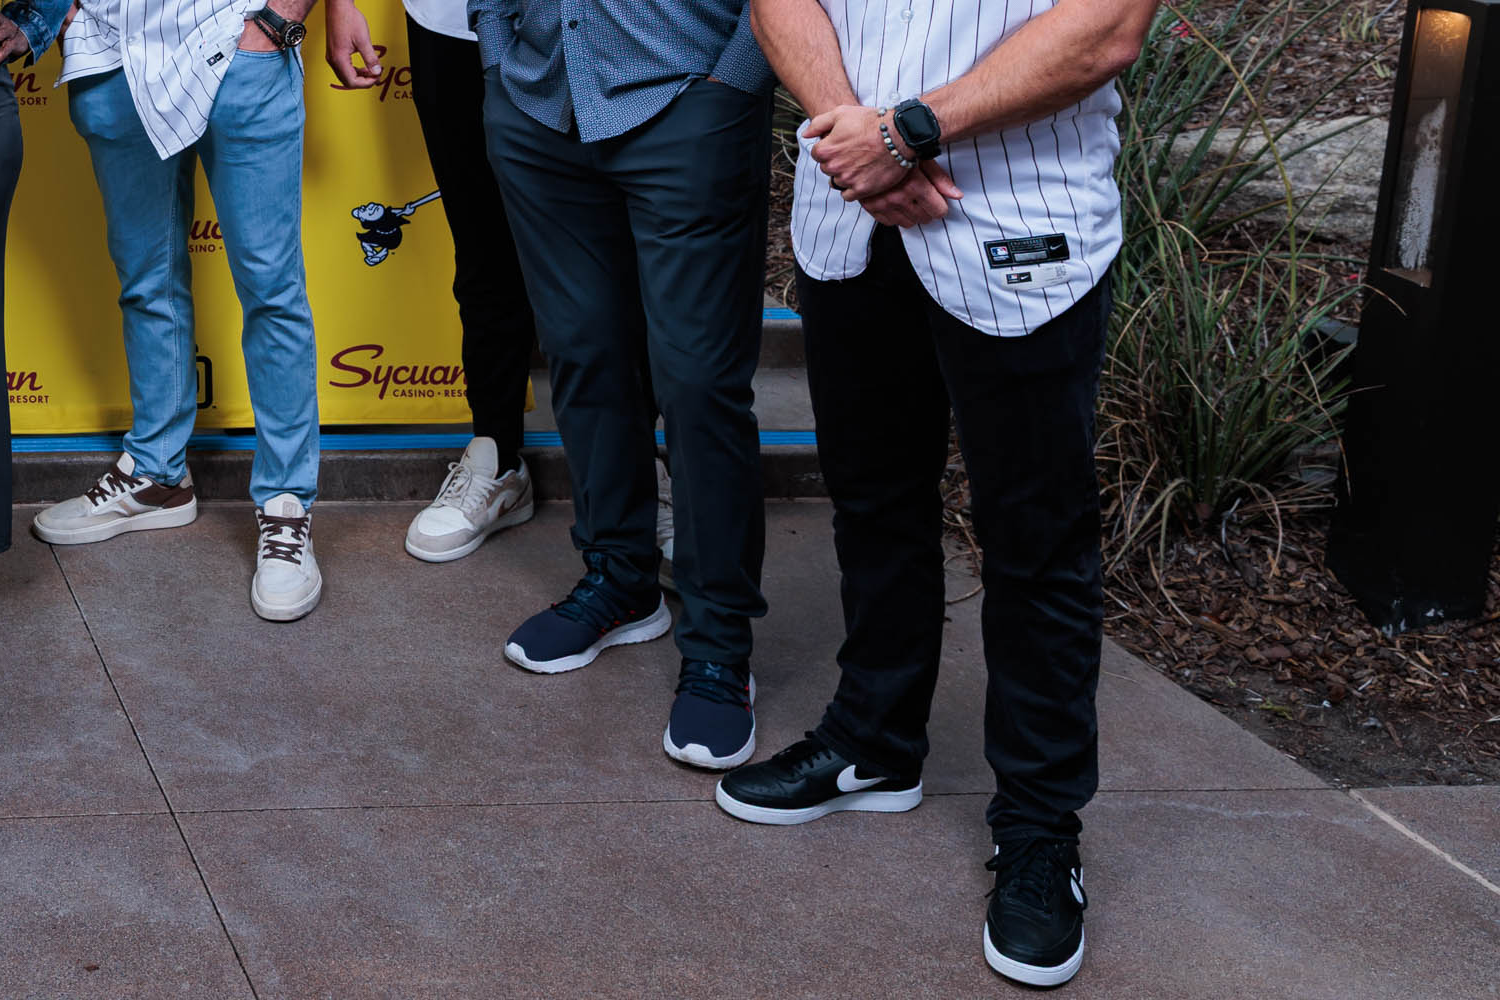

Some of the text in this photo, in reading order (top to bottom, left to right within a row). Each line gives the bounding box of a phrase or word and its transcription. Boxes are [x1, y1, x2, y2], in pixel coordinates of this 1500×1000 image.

[19, 97, 47, 105] SORT
[189, 244, 216, 252] SINO
[393, 389, 467, 398] CASINO RES
[10, 395, 49, 403] RESORT
